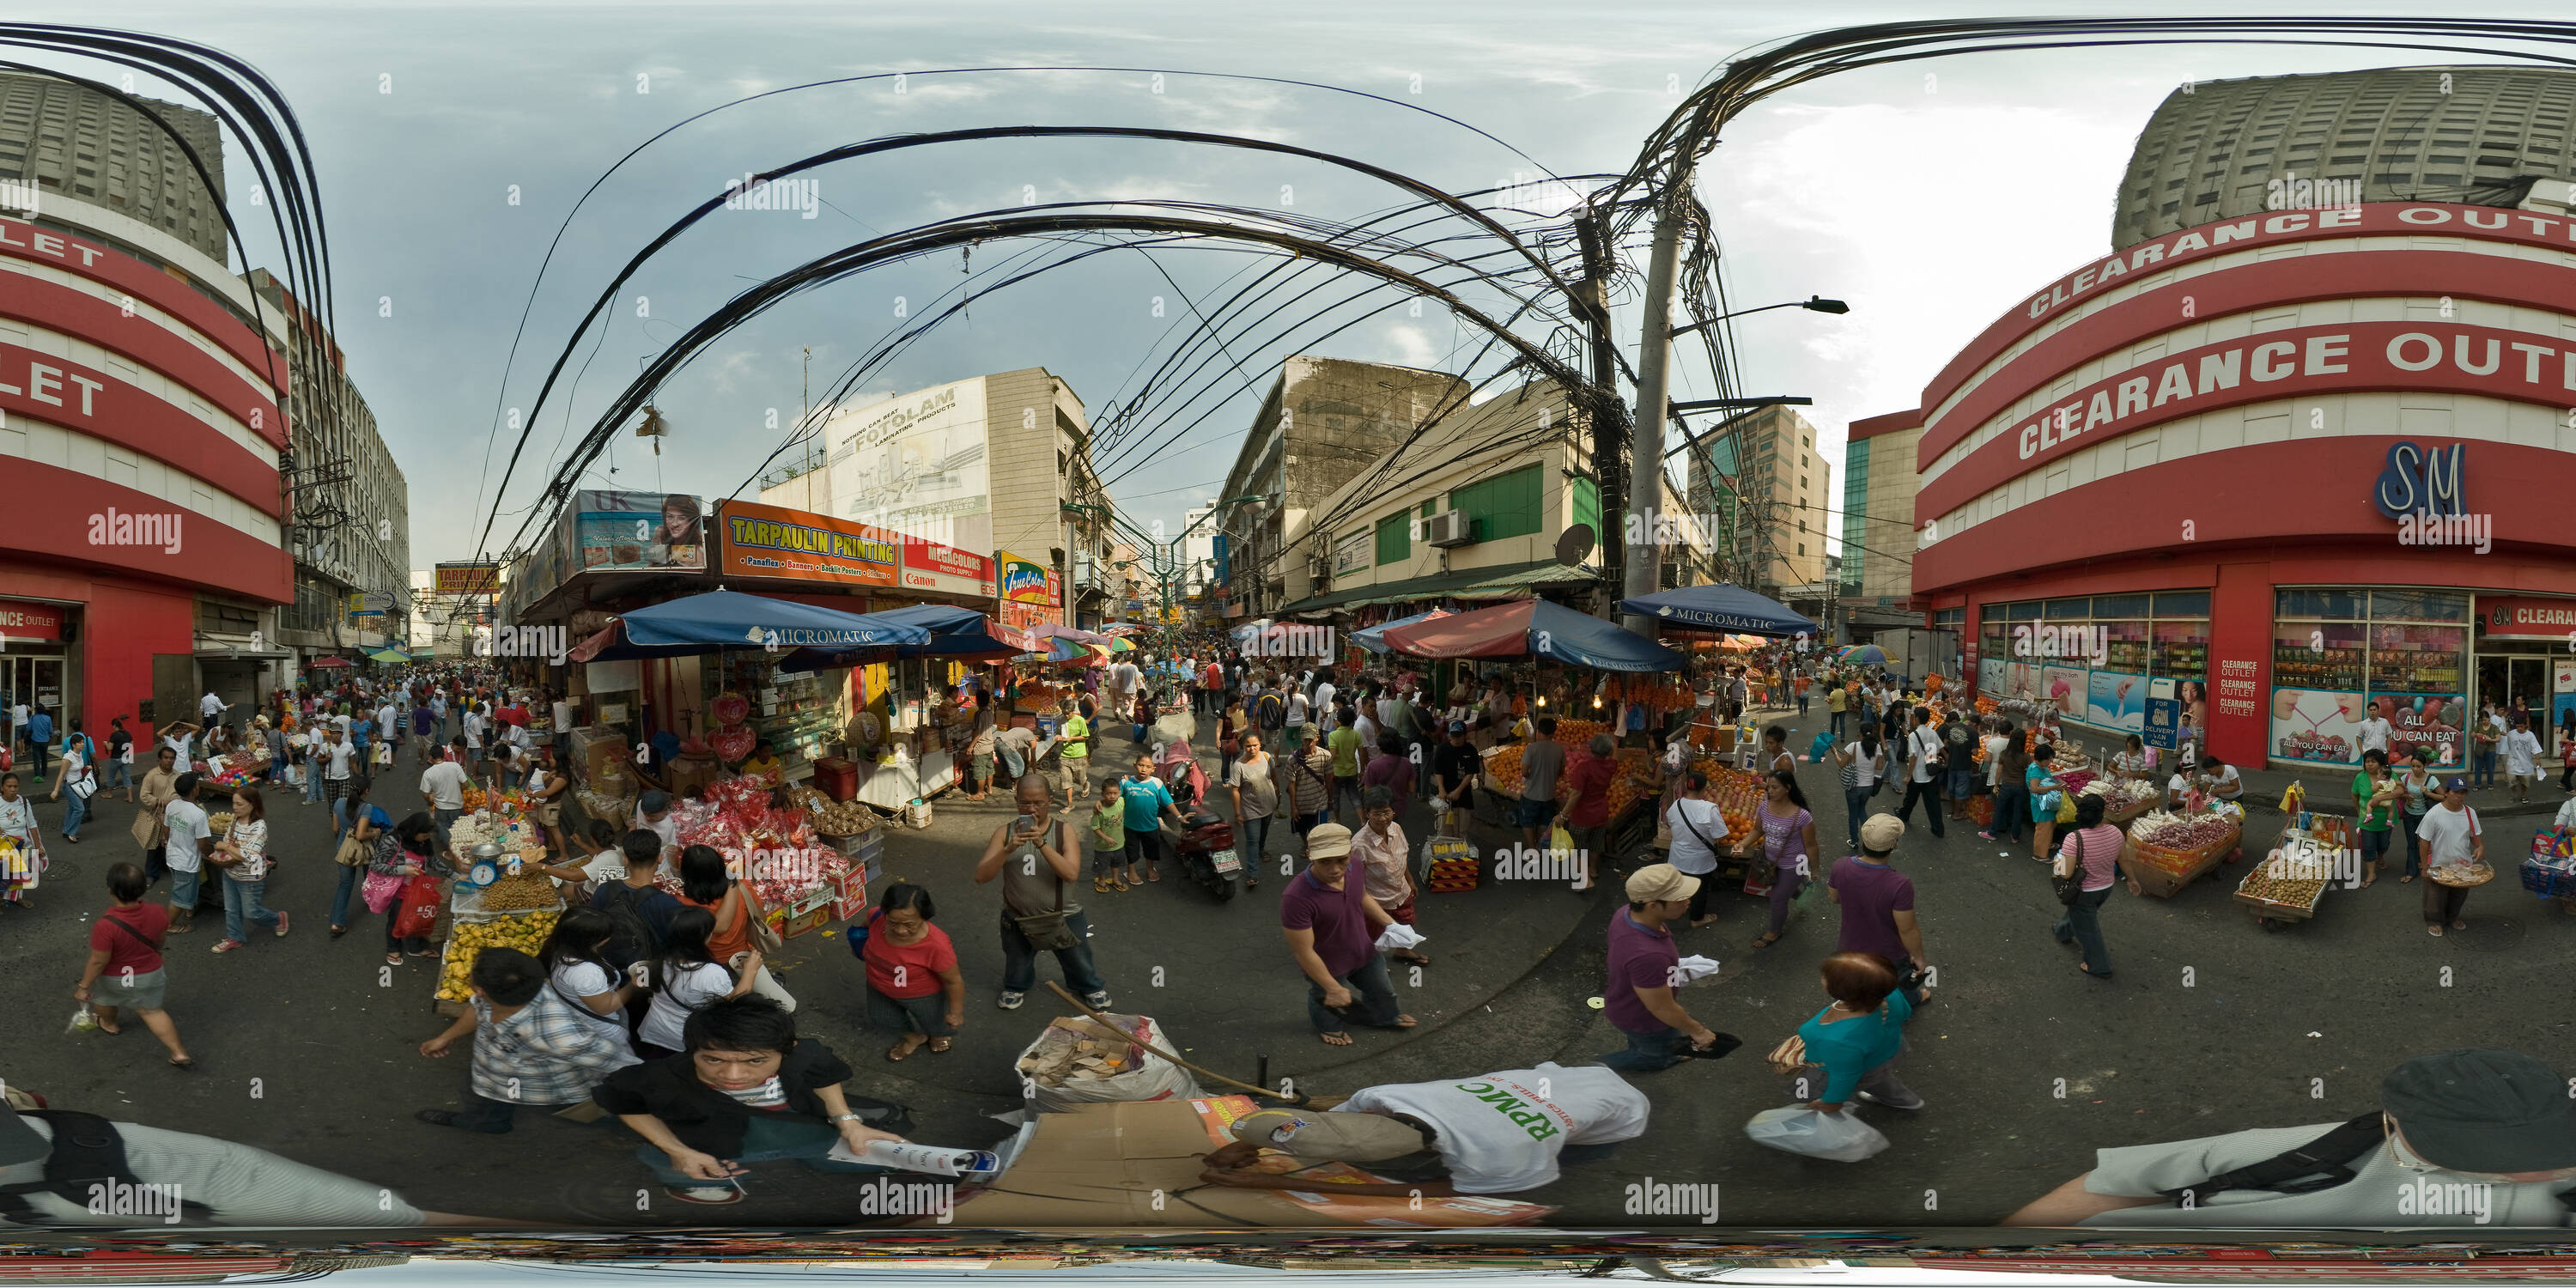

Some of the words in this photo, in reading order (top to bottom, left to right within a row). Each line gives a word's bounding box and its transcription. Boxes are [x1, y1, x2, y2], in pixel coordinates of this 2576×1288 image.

[2030, 209, 2362, 319] CLEARANCE
[2397, 208, 2576, 242] OUT
[2019, 334, 2350, 460] CLEARANCE
[841, 427, 866, 446] NOTHING
[868, 418, 881, 428] CAN
[883, 408, 899, 420] BEAT
[855, 387, 956, 453] FOTOLAM
[874, 422, 914, 447] LAMINATING
[917, 402, 956, 423] PRODUCTS
[2377, 442, 2464, 518] SM
[730, 517, 829, 555] TARPAULIN
[833, 532, 895, 565] PRINTING
[927, 545, 981, 571] MEGACOLORS
[747, 556, 779, 568] Panaflex
[787, 561, 814, 571] Banners
[821, 563, 841, 574] Backlit
[841, 566, 862, 576] Posters
[939, 564, 957, 574] PHOTO
[957, 568, 974, 578] SUPPLY
[438, 568, 497, 581] TARPAULIN
[906, 573, 936, 587] Canon
[981, 584, 996, 596] EOS
[1050, 580, 1058, 595] ID
[26, 615, 55, 627] OUTLET
[1675, 608, 1776, 630] MICROMATIC
[2493, 605, 2512, 625] SM
[2517, 608, 2576, 625] CLEARA
[773, 629, 874, 644] MICROMATIC
[2221, 659, 2257, 670] CLEARANCE
[2221, 668, 2256, 677] OUTLET
[2221, 679, 2256, 690] CLEARANCE
[2220, 687, 2256, 698] OUTLET
[2220, 698, 2255, 709] CLEARANCE
[2152, 708, 2169, 726] SM
[2219, 706, 2255, 717] OUTLET
[2404, 715, 2425, 726] ALL
[2145, 726, 2175, 735] DELIVERY
[2405, 731, 2433, 742] CAN
[2436, 731, 2458, 742] EAT
[2283, 739, 2296, 748] ALL
[2296, 741, 2314, 750] YOU
[2315, 743, 2333, 751] CAN
[2297, 839, 2316, 857] 15
[1218, 859, 1239, 868] PRESS
[1455, 1081, 1560, 1143] RPMC
